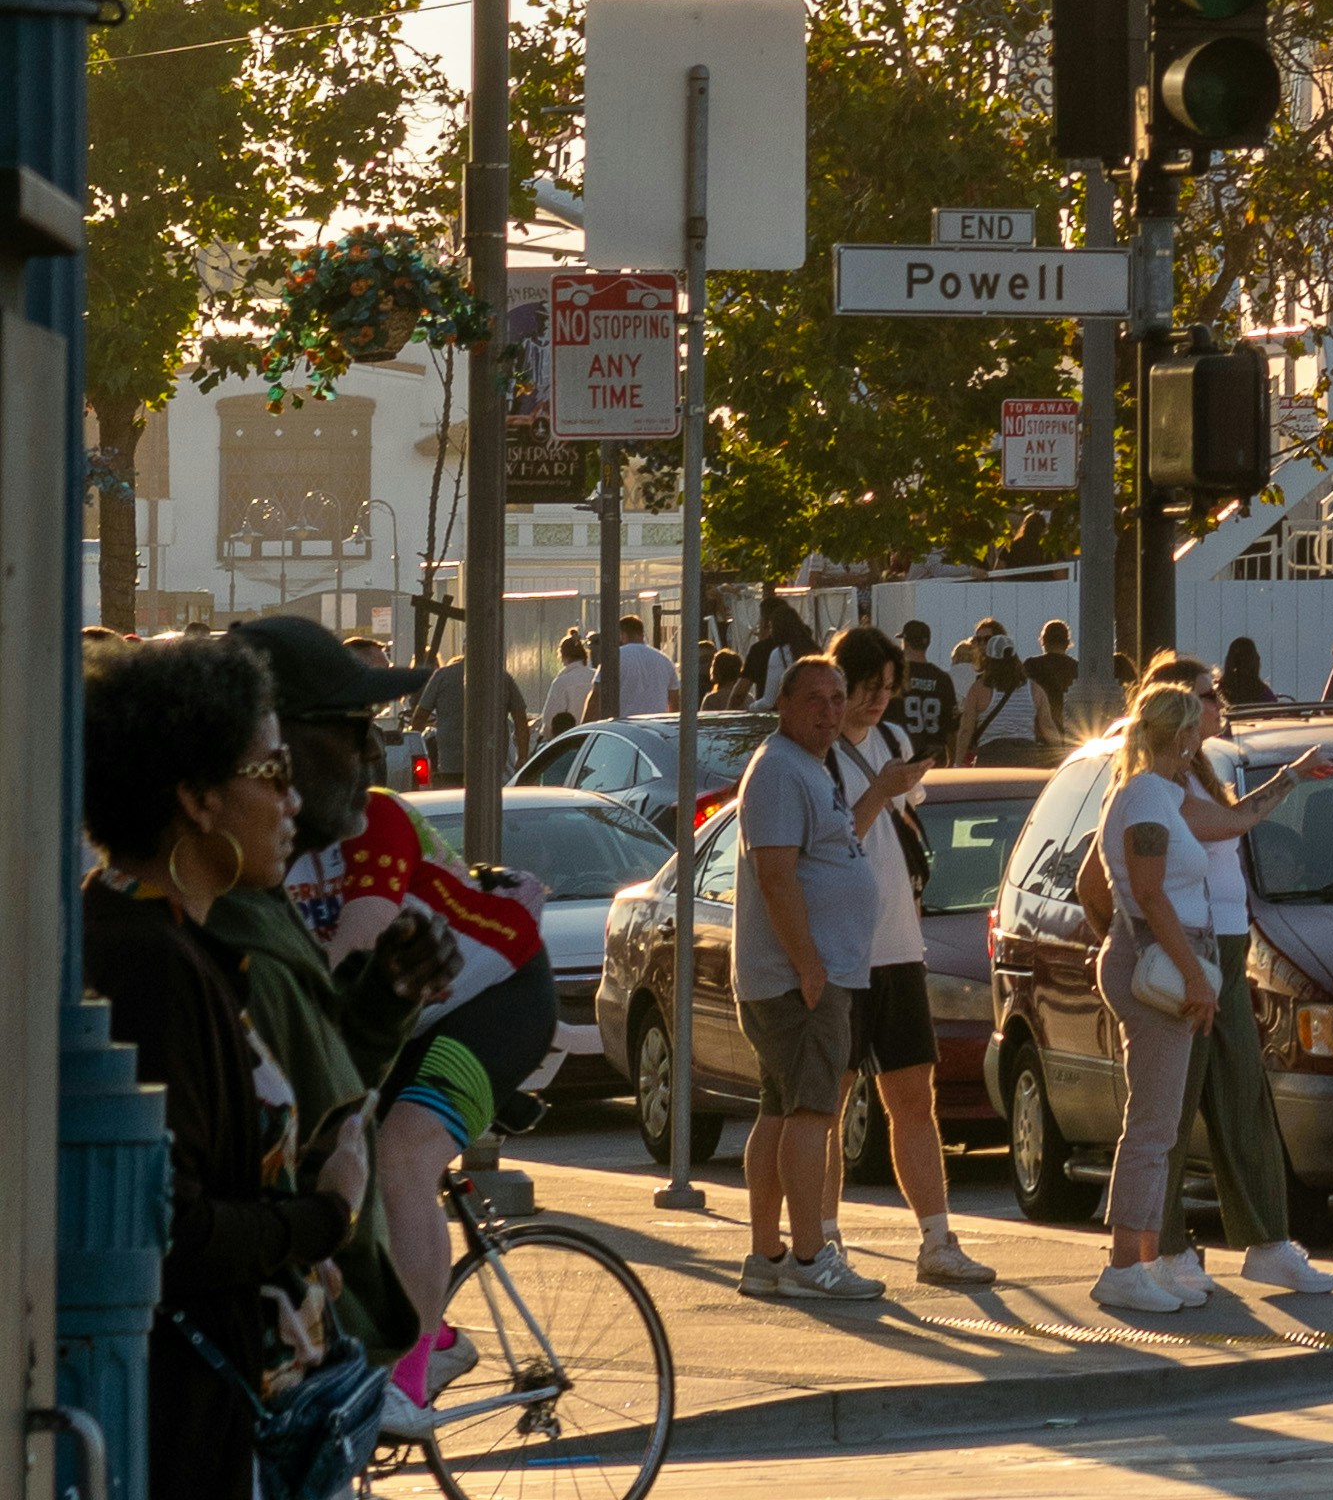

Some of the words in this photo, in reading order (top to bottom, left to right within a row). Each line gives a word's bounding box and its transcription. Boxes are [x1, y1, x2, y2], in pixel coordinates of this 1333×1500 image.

[961, 215, 1014, 240] END
[906, 262, 1064, 301] Powell
[556, 308, 587, 343] NO
[592, 314, 670, 340] STOPPING
[588, 353, 643, 378] ANY
[588, 384, 643, 409] TIME
[1008, 402, 1074, 413] TOW-AWAY
[1005, 415, 1024, 435] NO
[1027, 419, 1075, 435] STOPPING
[1026, 439, 1057, 453] ANY
[1023, 457, 1058, 472] TIME
